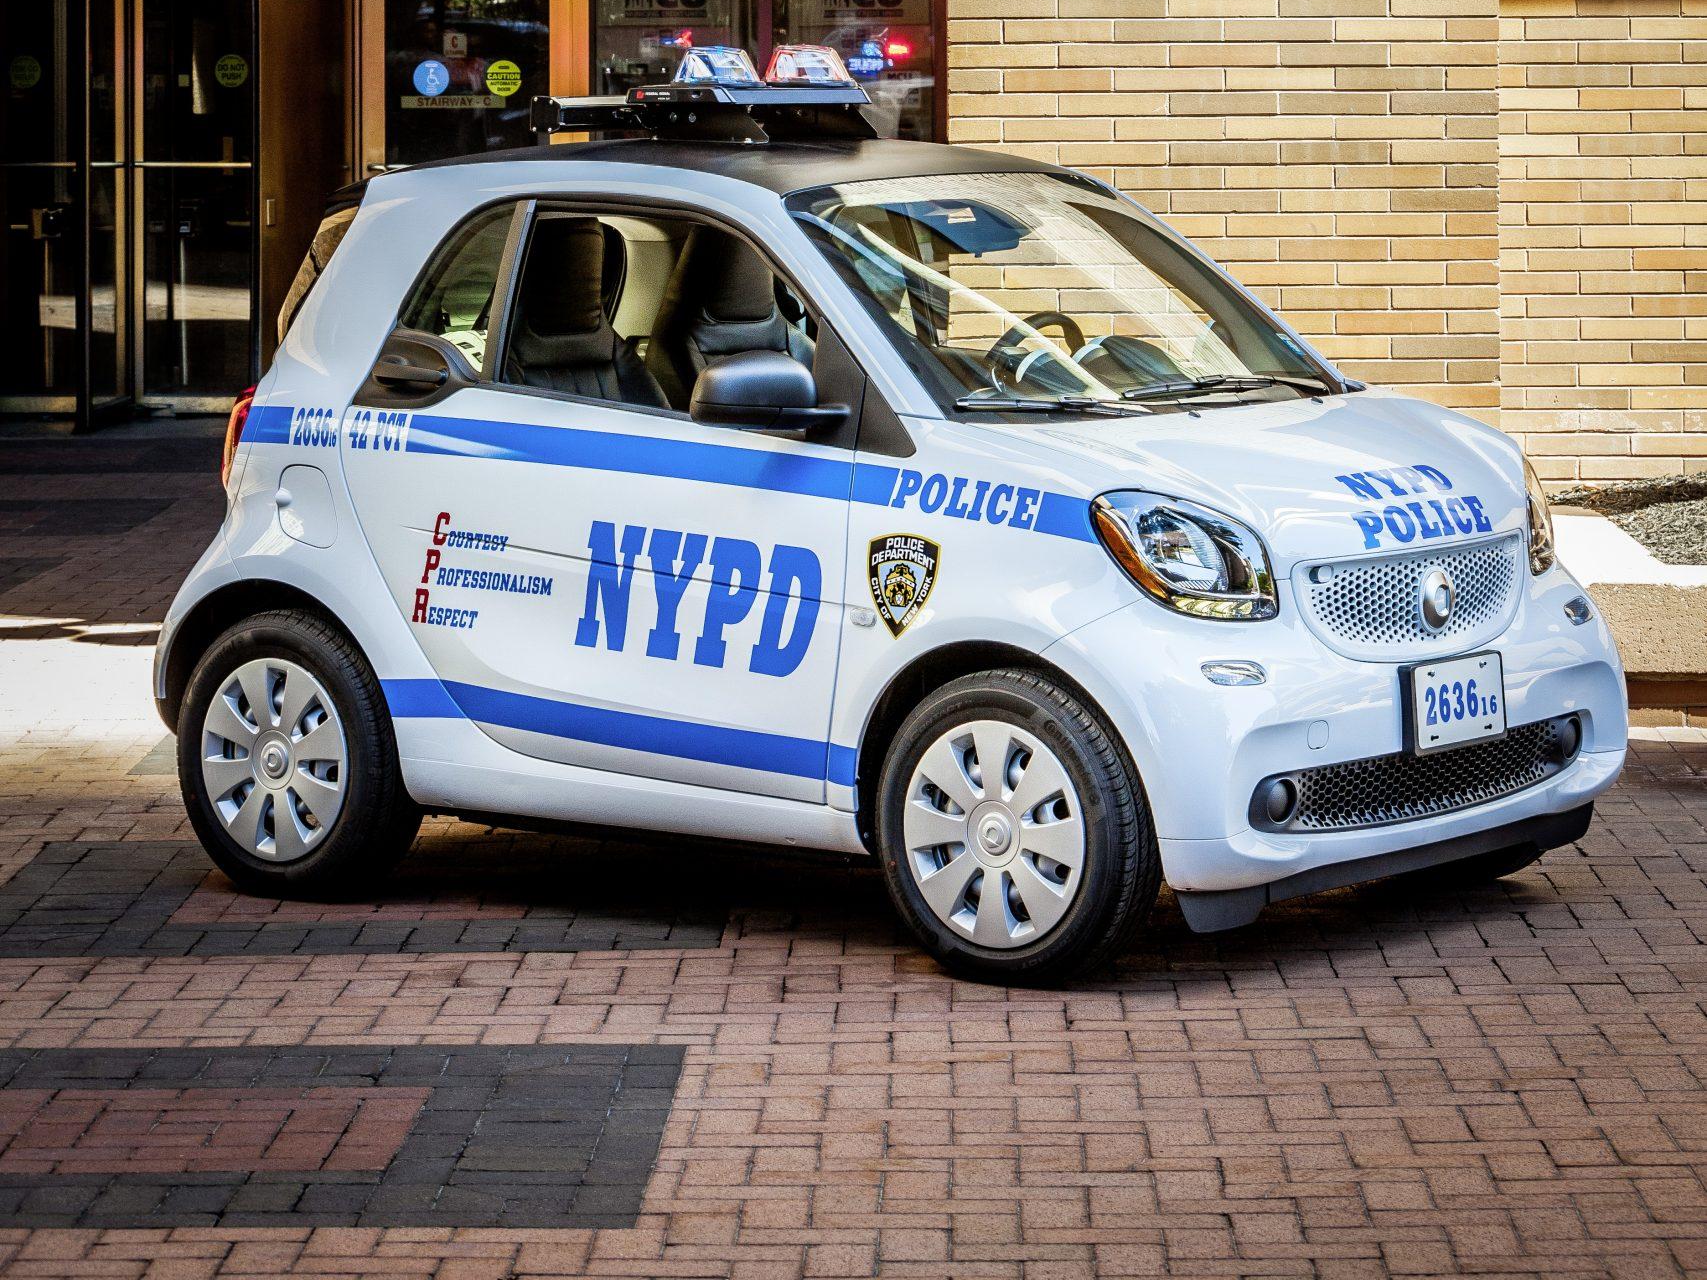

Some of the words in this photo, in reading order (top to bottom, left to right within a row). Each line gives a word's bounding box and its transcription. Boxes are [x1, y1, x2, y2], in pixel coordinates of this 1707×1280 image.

[487, 72, 521, 80] CAUTION
[416, 96, 473, 107] STAIRWAY
[1335, 464, 1453, 502] NYPD
[891, 468, 1041, 530] POLICE
[1353, 495, 1493, 549] POLICE
[886, 536, 925, 553] POLICE
[871, 548, 935, 570] DEPARTMENT
[574, 520, 822, 678] NYPD
[871, 577, 883, 604] CITY
[916, 576, 933, 602] YORK
